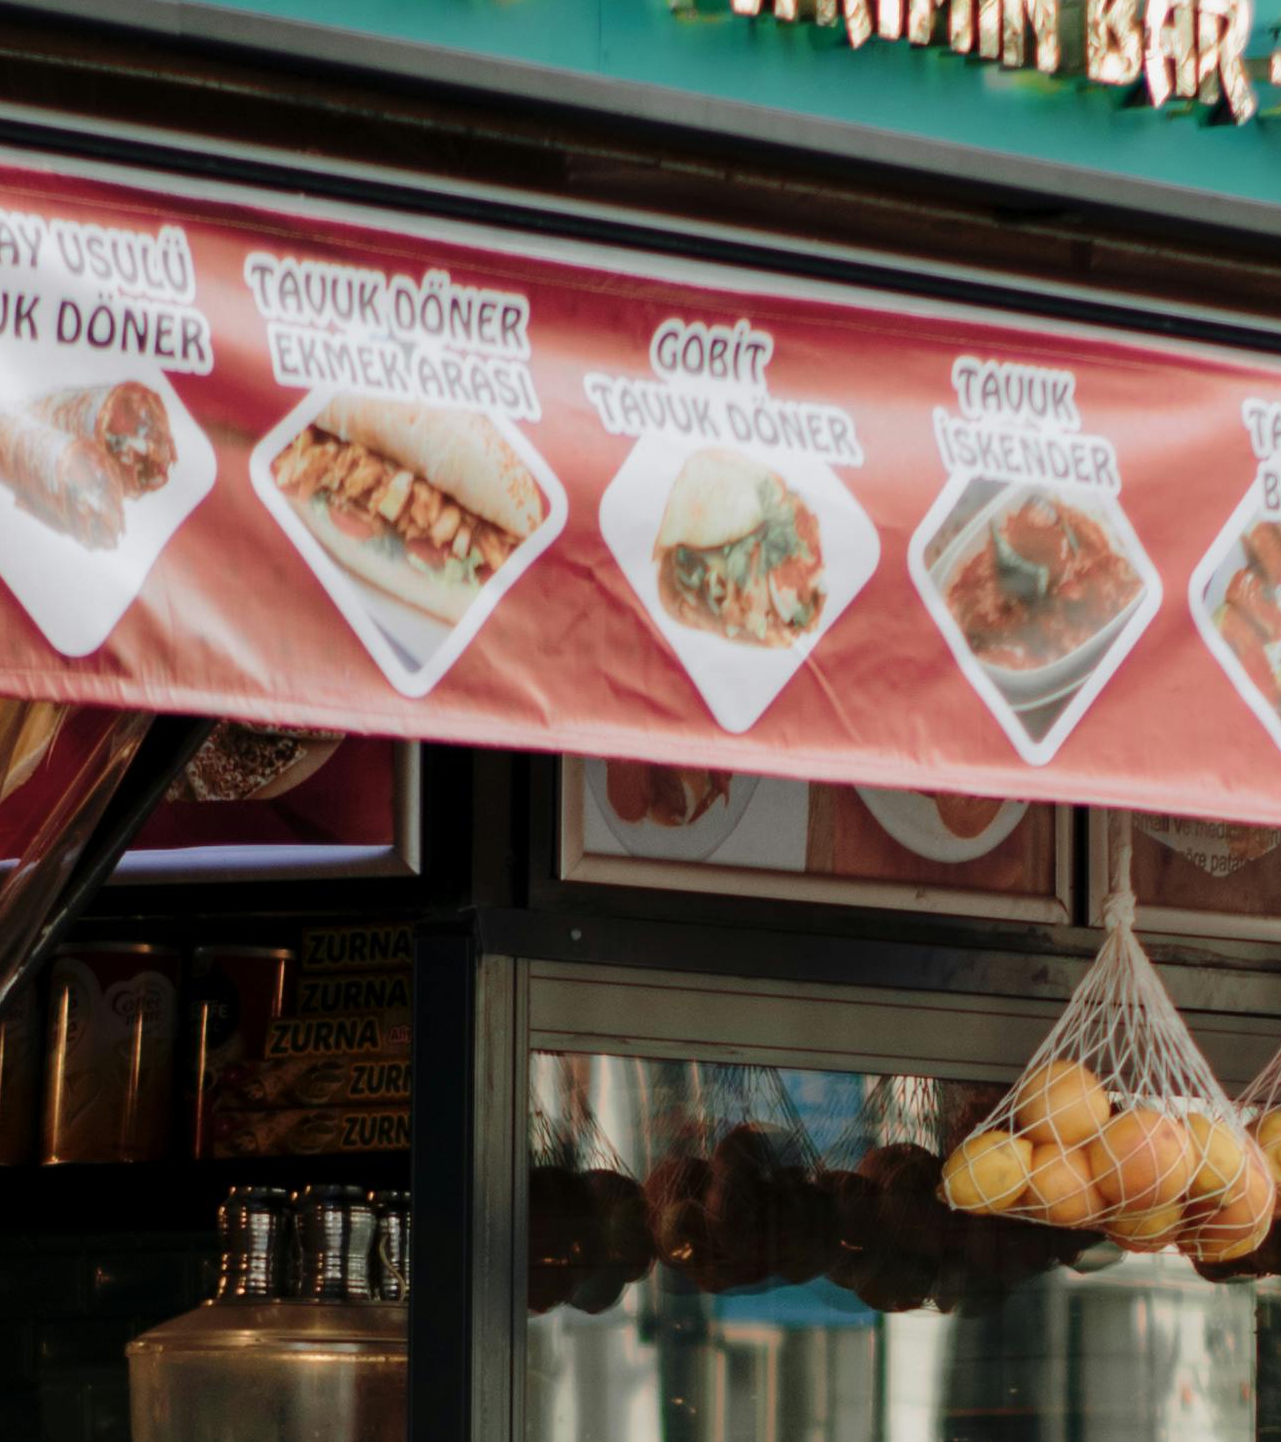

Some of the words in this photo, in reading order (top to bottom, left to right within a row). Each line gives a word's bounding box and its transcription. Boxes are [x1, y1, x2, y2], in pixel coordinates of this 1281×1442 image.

[56, 226, 191, 295] USULÜ
[55, 293, 208, 368] DÖNER
[249, 262, 381, 326] TAVUK
[392, 275, 526, 349] DÖNER
[276, 332, 414, 392] EKMEK
[418, 350, 539, 414] ARASI
[956, 363, 1074, 420] TAVUK
[592, 381, 719, 440] TAVUK
[730, 393, 855, 458] DÖNER
[936, 414, 1117, 487] İSKENDER
[306, 929, 412, 966] ZURNA
[301, 978, 409, 1014] ZURNA
[270, 1018, 381, 1055] ZURNA
